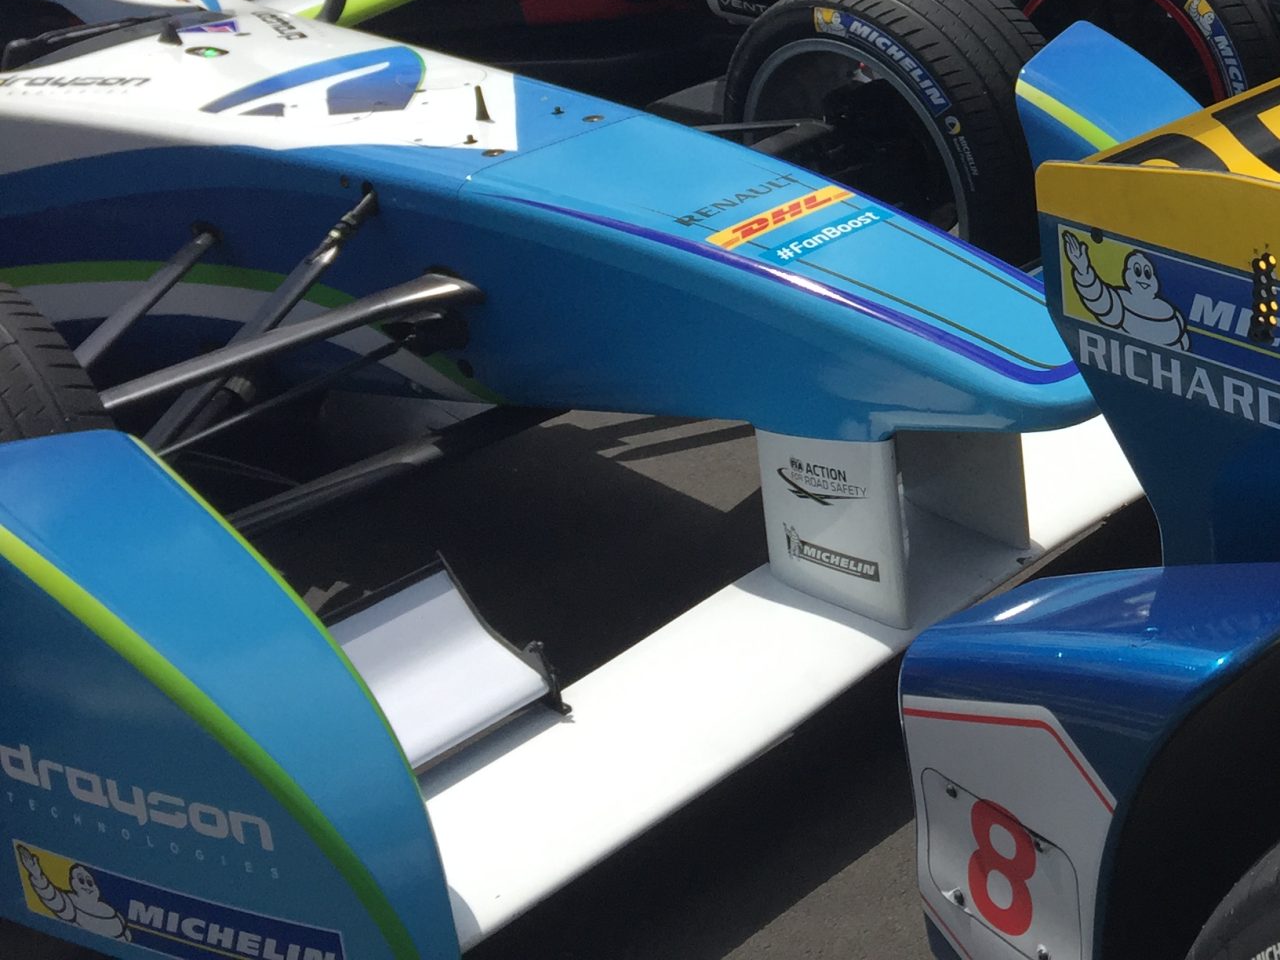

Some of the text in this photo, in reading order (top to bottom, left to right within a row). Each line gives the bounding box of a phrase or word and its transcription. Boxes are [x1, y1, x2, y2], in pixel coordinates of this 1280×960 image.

[850, 20, 947, 106] MICHELIN
[674, 173, 800, 227] RENAULT
[732, 195, 833, 239] DHL
[776, 211, 880, 260] #FanBoost
[804, 475, 829, 490] ROAD
[830, 481, 867, 496] SAFETY
[806, 463, 847, 482] ACTION
[803, 545, 875, 576] MICHELIN
[0, 744, 274, 852] drayson
[968, 798, 1036, 937] 8
